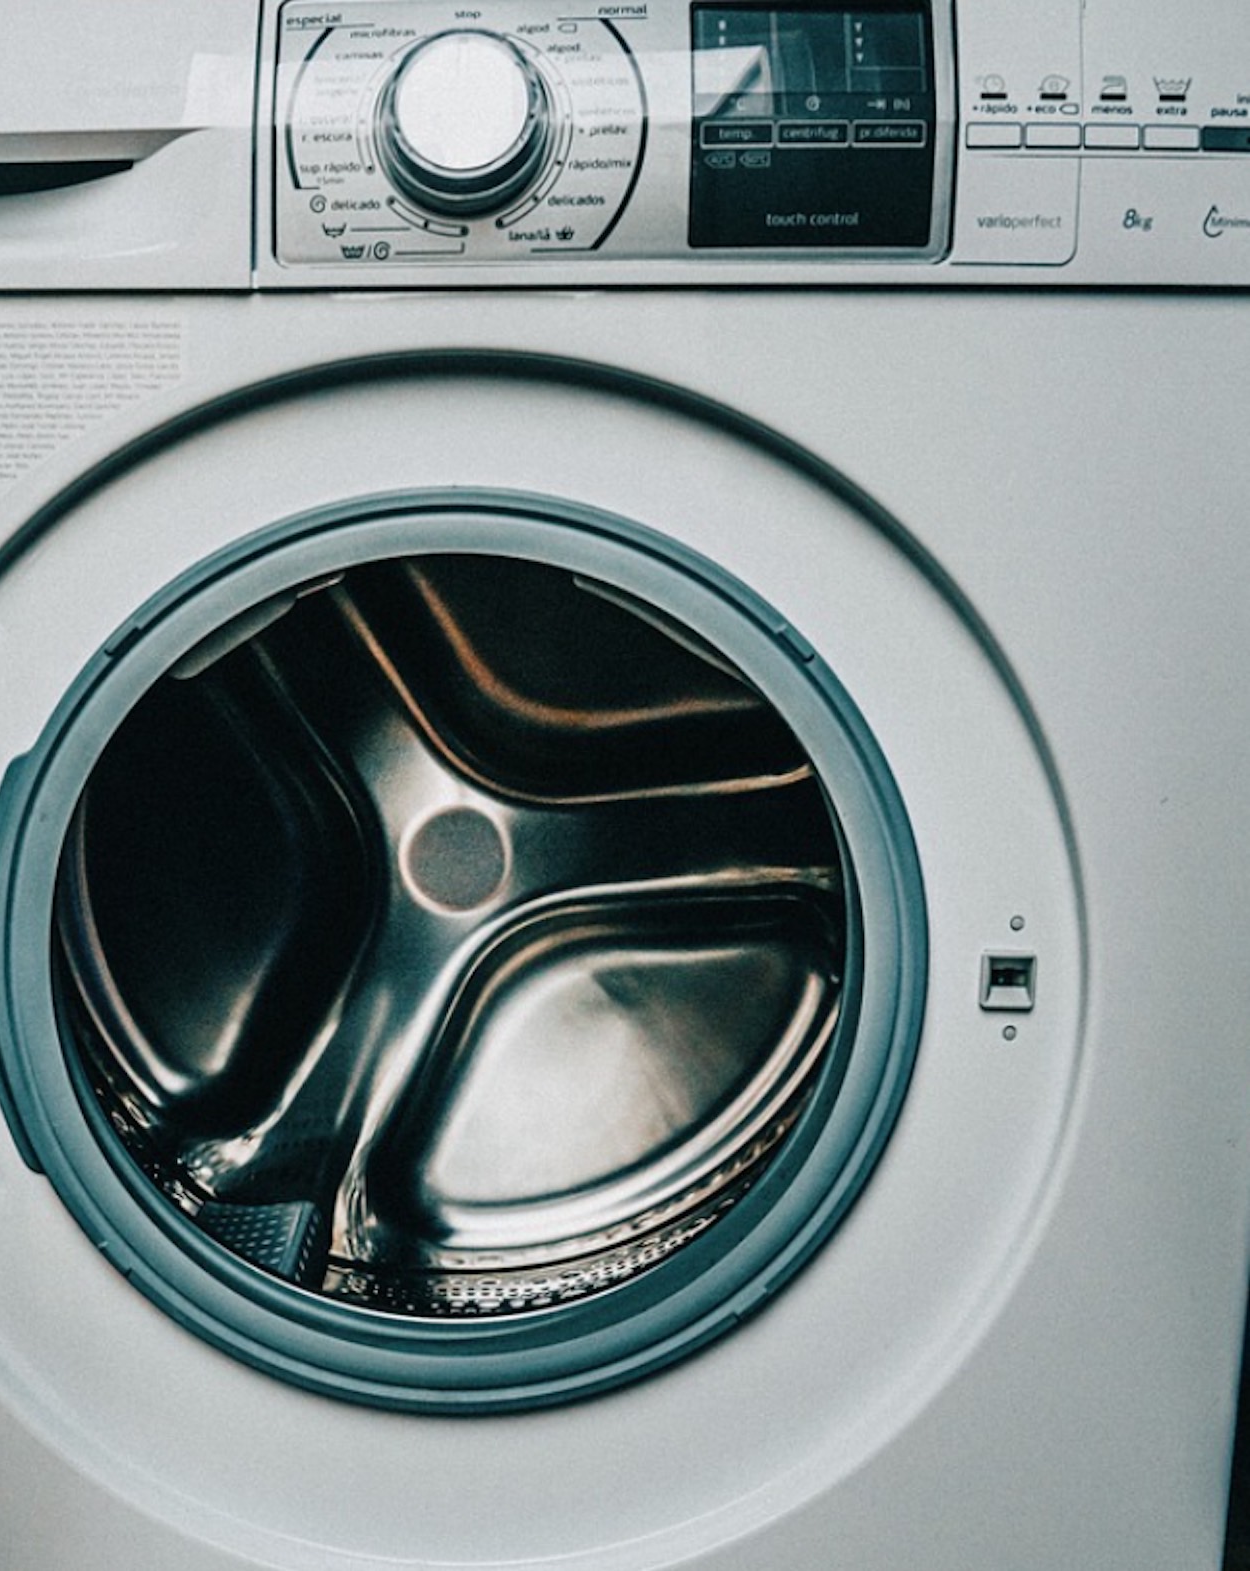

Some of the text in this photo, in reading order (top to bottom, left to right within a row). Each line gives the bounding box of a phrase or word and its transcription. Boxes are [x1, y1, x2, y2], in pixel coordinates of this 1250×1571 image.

[454, 10, 482, 19] stop
[597, 4, 647, 15] normal
[286, 13, 342, 27] especial
[350, 28, 417, 38] microfibras
[335, 51, 384, 60] camisas
[980, 103, 1018, 115] rápido
[1034, 105, 1057, 115] eco
[1091, 105, 1133, 115] menos
[1155, 105, 1188, 116] extra
[1210, 107, 1248, 119] pausa
[313, 133, 353, 142] escura
[330, 199, 380, 211] delicado
[547, 194, 605, 206] delicados
[766, 212, 859, 226] touch control
[977, 213, 1061, 230] varioperfect
[1123, 208, 1153, 230] 8kg
